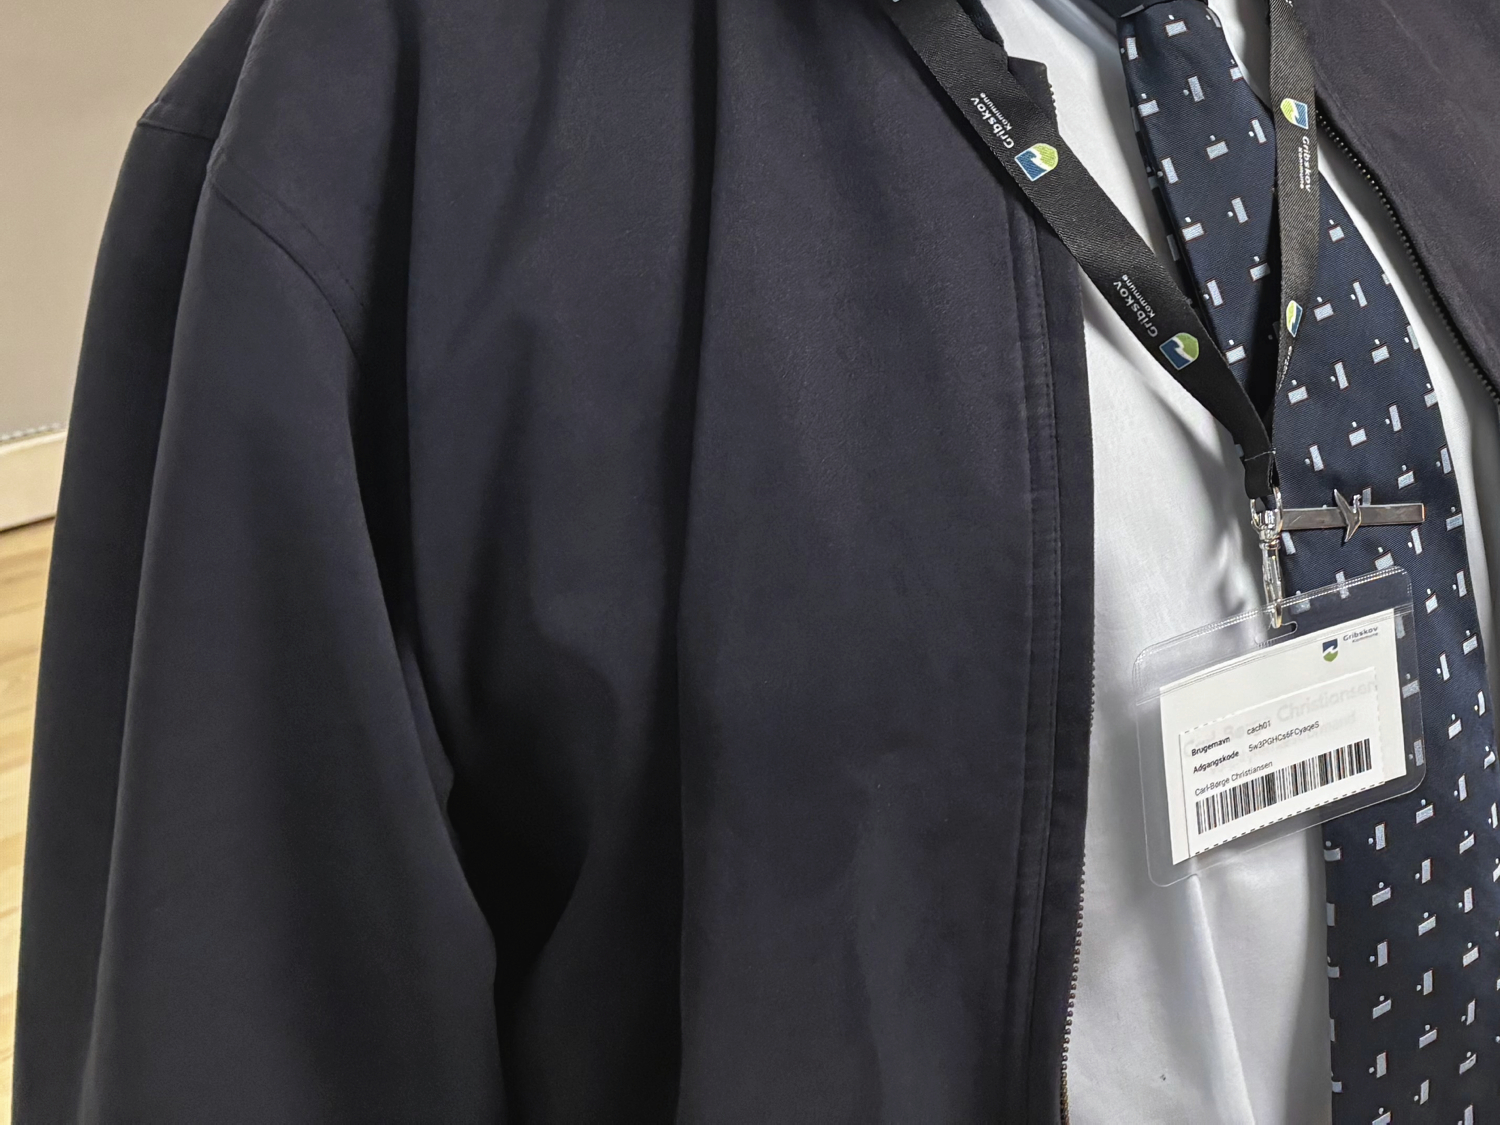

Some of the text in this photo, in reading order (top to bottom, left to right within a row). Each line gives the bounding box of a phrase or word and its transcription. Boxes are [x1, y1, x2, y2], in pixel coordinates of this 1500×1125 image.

[969, 96, 1015, 150] Gribskov
[978, 91, 1014, 131] Kommune
[1301, 134, 1312, 193] Gribskov
[1112, 279, 1159, 338] Gribskov
[1121, 273, 1156, 318] Kommune
[1342, 626, 1379, 641] Gribskov
[1192, 750, 1239, 774] Adgangskode
[1231, 761, 1273, 782] Christiansen
